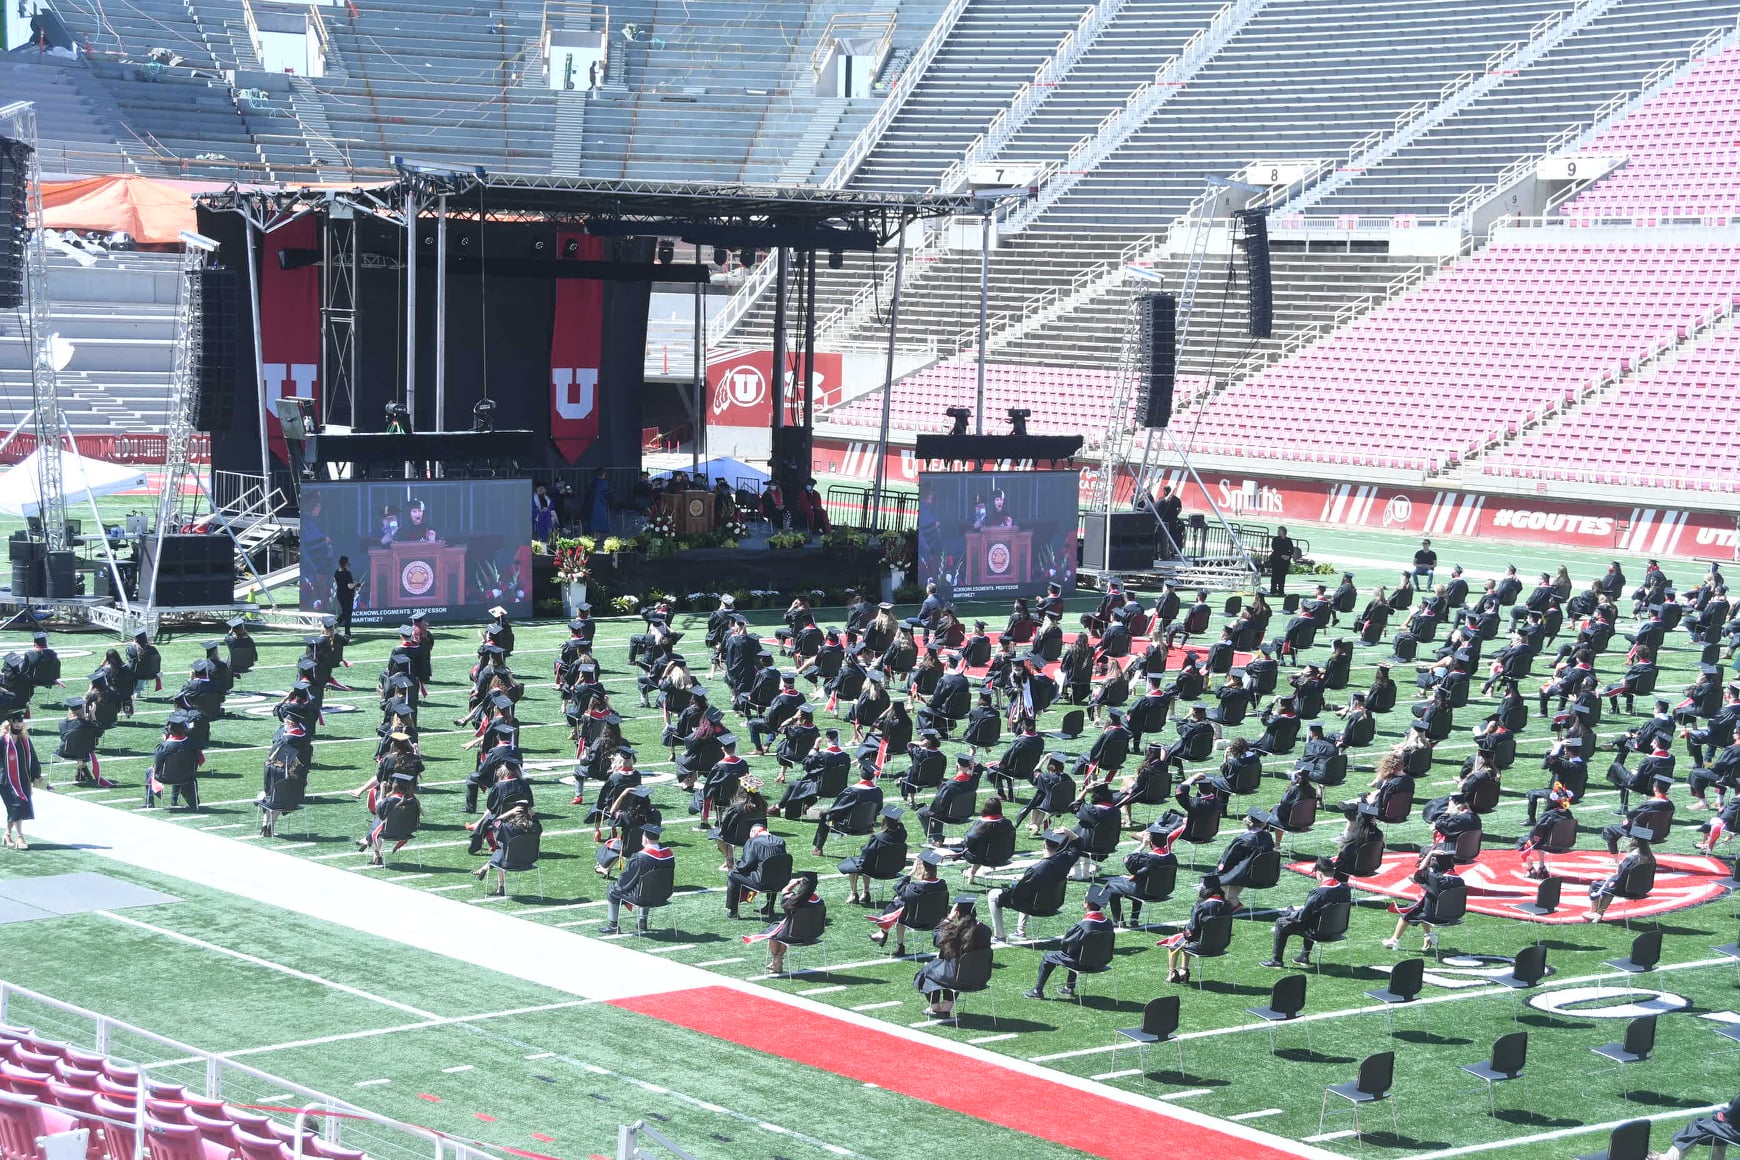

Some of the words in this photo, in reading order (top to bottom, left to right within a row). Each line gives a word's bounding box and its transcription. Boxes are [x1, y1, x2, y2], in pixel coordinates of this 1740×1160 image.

[995, 169, 1005, 182] 7
[1270, 168, 1278, 182] 8
[1567, 162, 1577, 177] 9
[263, 363, 318, 418] U
[552, 367, 598, 419] U
[733, 373, 759, 401] U
[1394, 500, 1410, 519] U
[1493, 509, 1614, 536] #GOUTES
